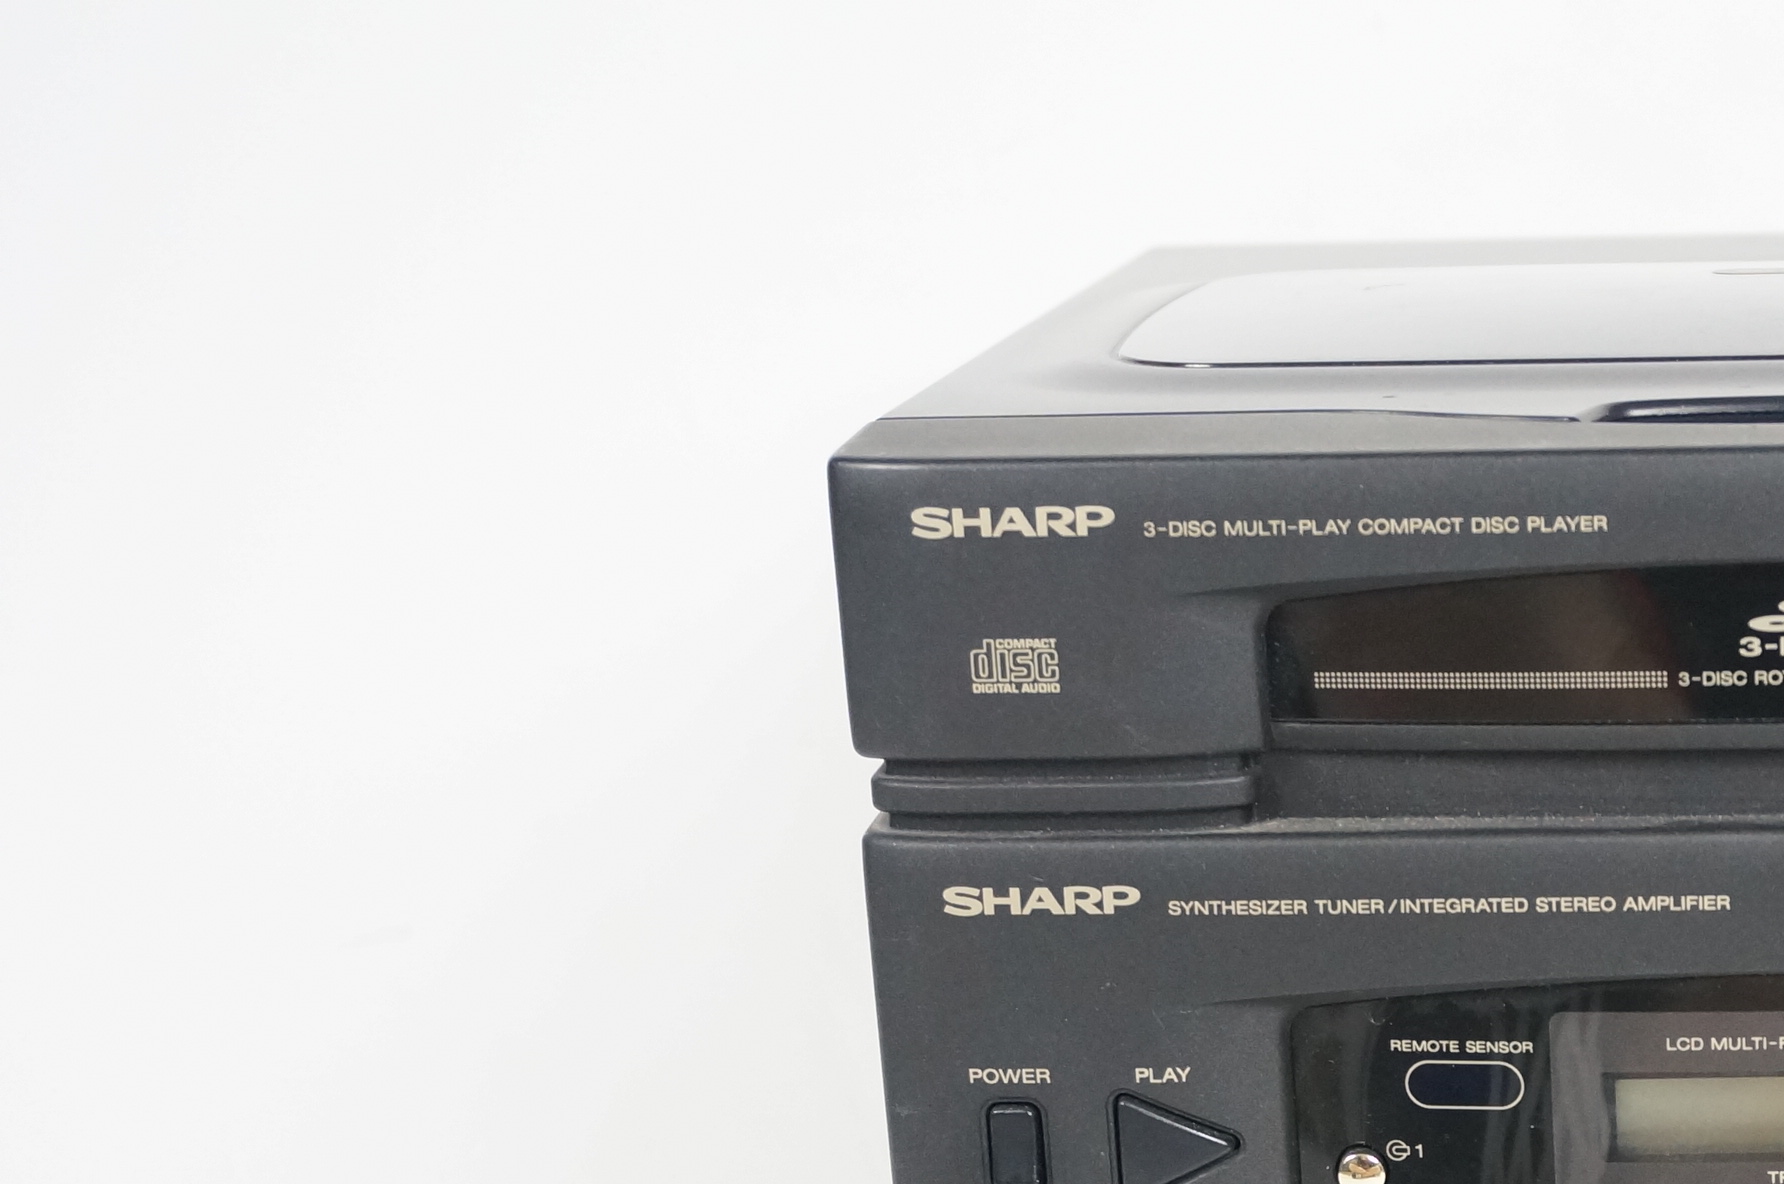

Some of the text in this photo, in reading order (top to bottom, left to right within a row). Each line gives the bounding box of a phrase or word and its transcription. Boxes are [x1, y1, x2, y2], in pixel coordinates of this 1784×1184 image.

[911, 506, 1115, 539] SHARP
[1144, 515, 1607, 537] 3-DISC MULTI-PLAY COMPACT DISC PLAYER
[995, 638, 1057, 650] COMPACT
[1679, 671, 1747, 686] 3-DISC
[972, 683, 1061, 694] DIGITAL AUDIO
[943, 886, 1140, 916] SHARP
[1169, 900, 1307, 915] SYNTHESIZER
[1536, 897, 1616, 912] STEREO
[1623, 895, 1730, 911] AMPLIFIER
[1391, 1040, 1533, 1053] REMOTE SENSOR
[1667, 1038, 1703, 1051] LCD
[969, 1069, 1050, 1084] POWER
[1135, 1067, 1190, 1083] PLAY
[1415, 1144, 1422, 1158] 1
